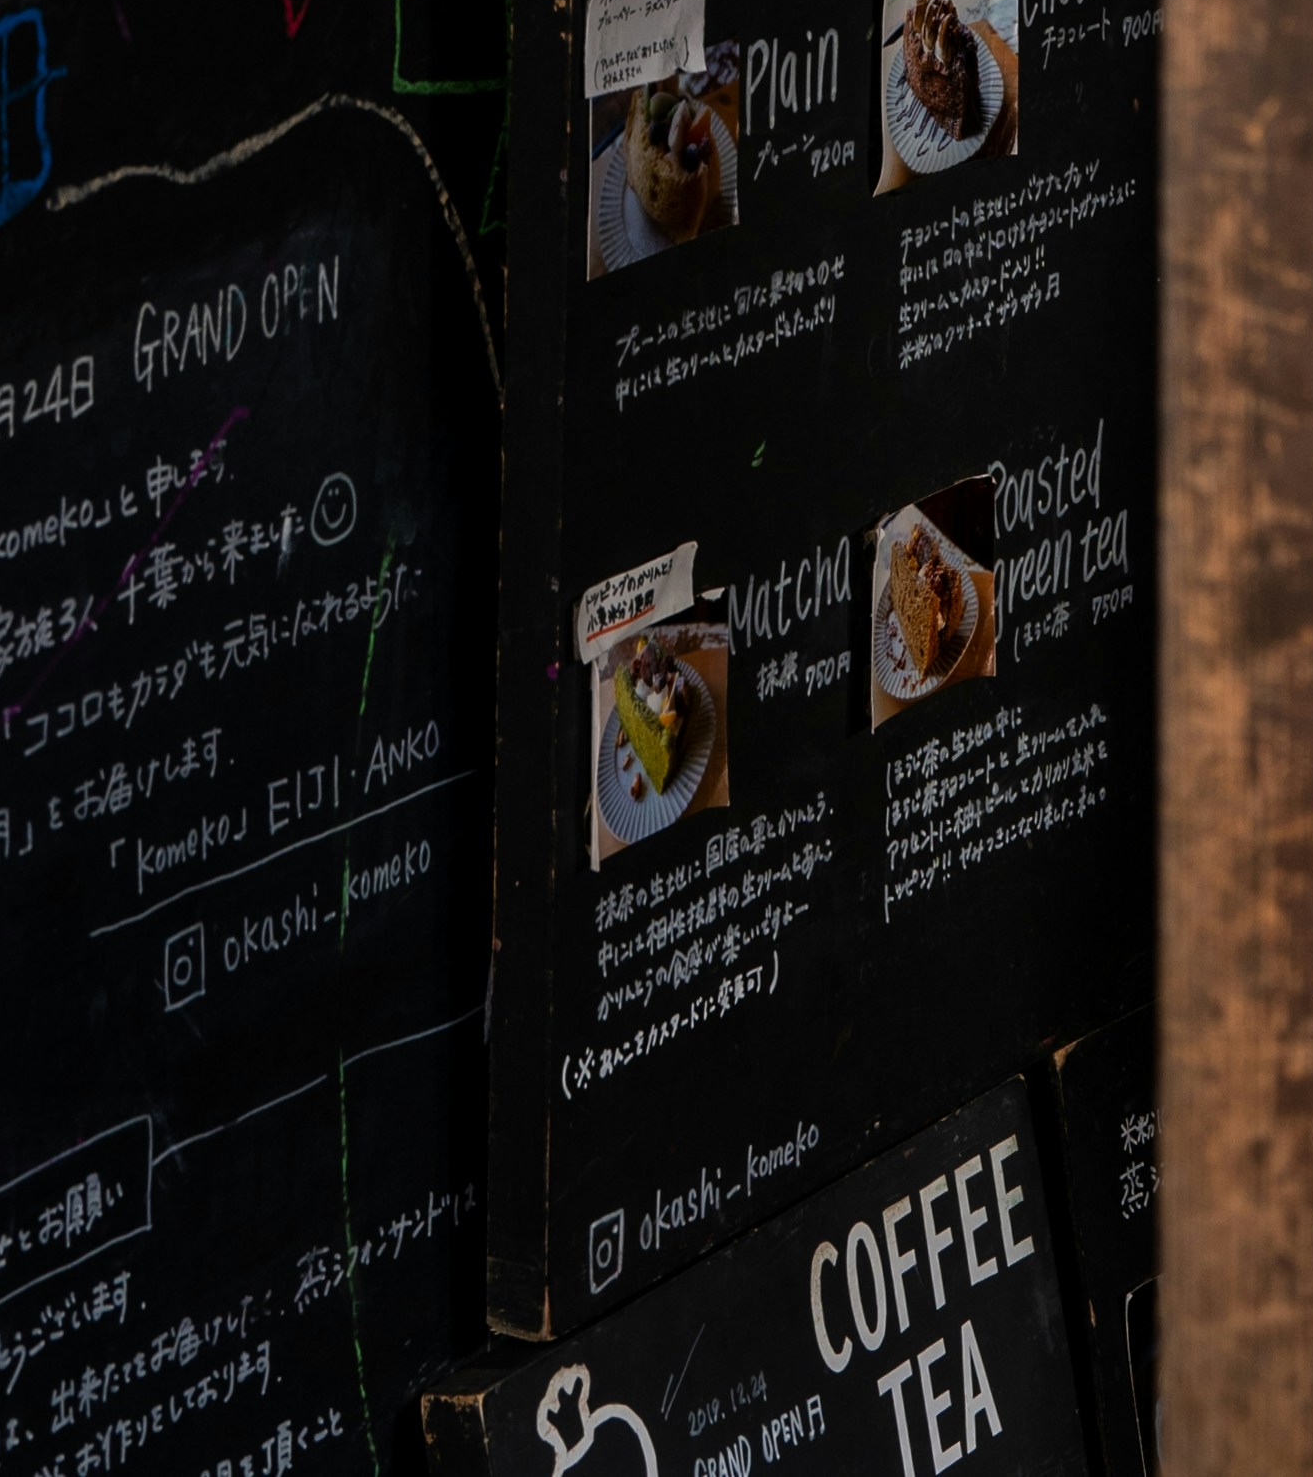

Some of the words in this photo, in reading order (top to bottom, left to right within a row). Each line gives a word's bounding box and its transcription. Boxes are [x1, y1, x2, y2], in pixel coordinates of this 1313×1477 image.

[745, 27, 841, 137] Plain
[1040, 5, 1112, 71] チョコレート
[809, 138, 856, 178] 720円
[133, 283, 249, 392] GRAND
[260, 255, 341, 341] OPEN
[987, 417, 1104, 540] Roasted
[726, 534, 853, 657] Matcha
[993, 528, 1073, 644] green
[1079, 507, 1129, 584] tea
[1091, 583, 1135, 626] 750円
[755, 649, 800, 703] 抹茶
[804, 649, 853, 698] 750円
[809, 1134, 1036, 1374] COFFEE
[760, 1404, 805, 1464] OPEN
[877, 1319, 1004, 1477] TEA
